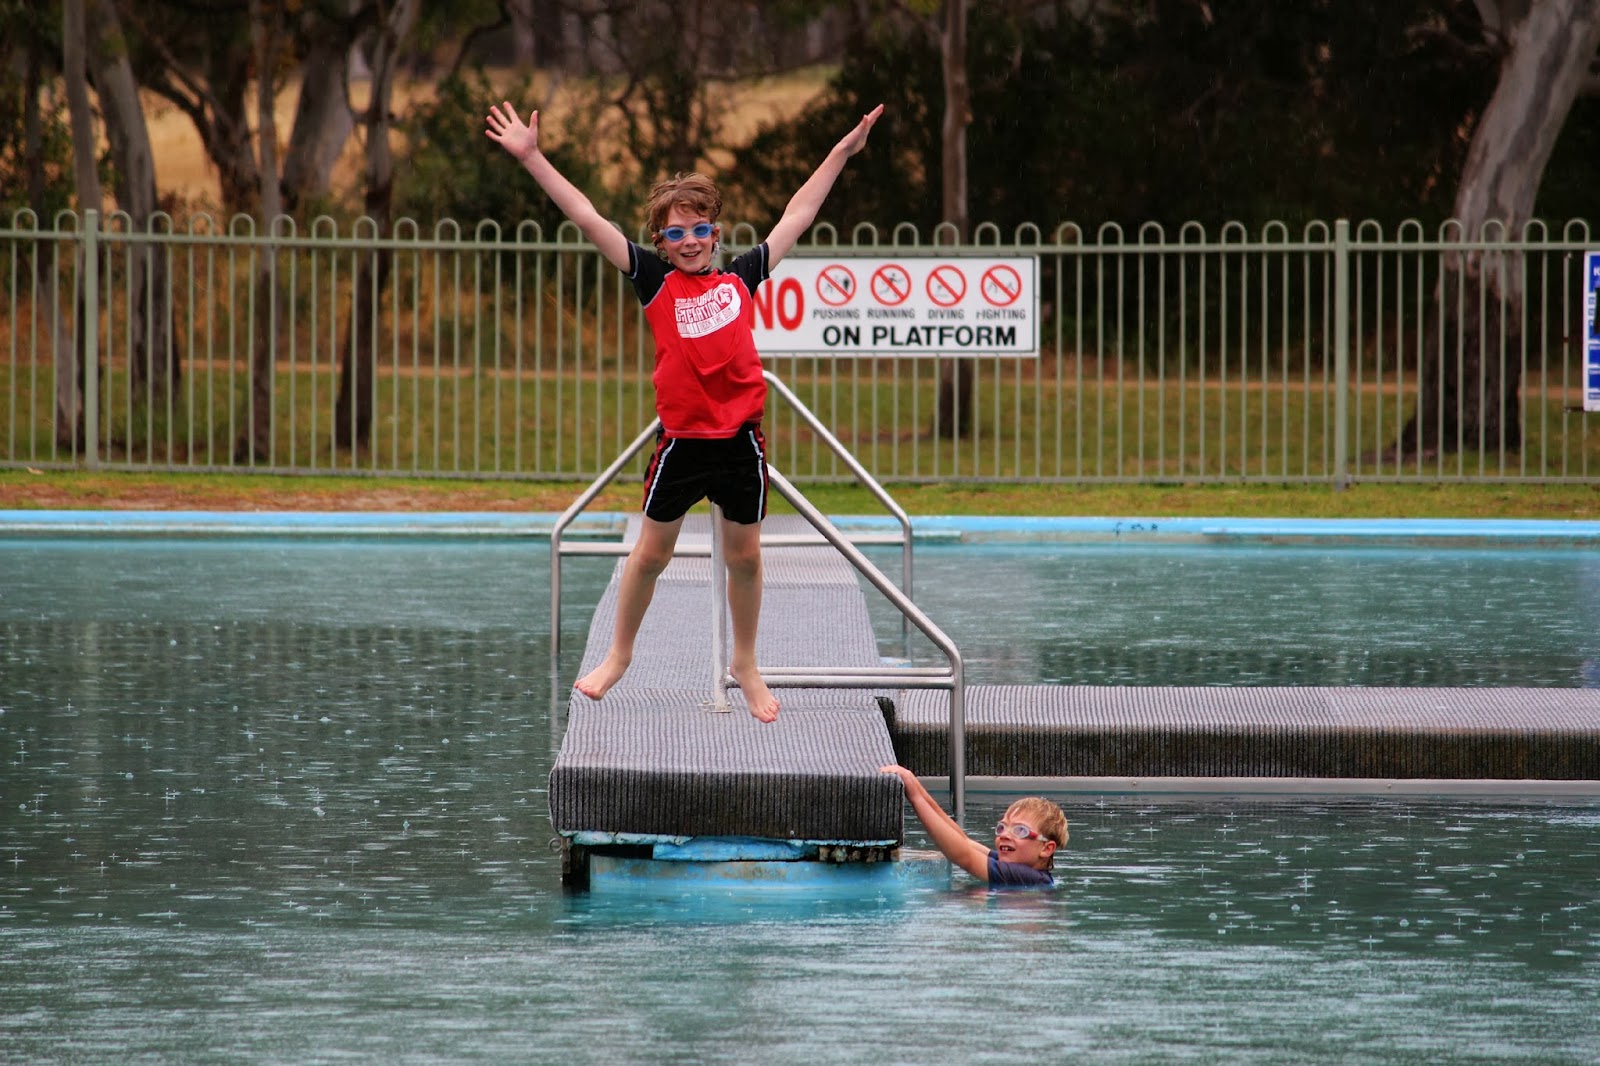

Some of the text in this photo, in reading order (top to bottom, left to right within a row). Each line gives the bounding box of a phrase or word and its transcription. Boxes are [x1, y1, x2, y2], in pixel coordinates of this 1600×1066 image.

[749, 277, 805, 331] NO
[812, 308, 1026, 320] PUSHING RUNNING DIVING FIGHTING
[822, 325, 1016, 346] ON PLATFORM
